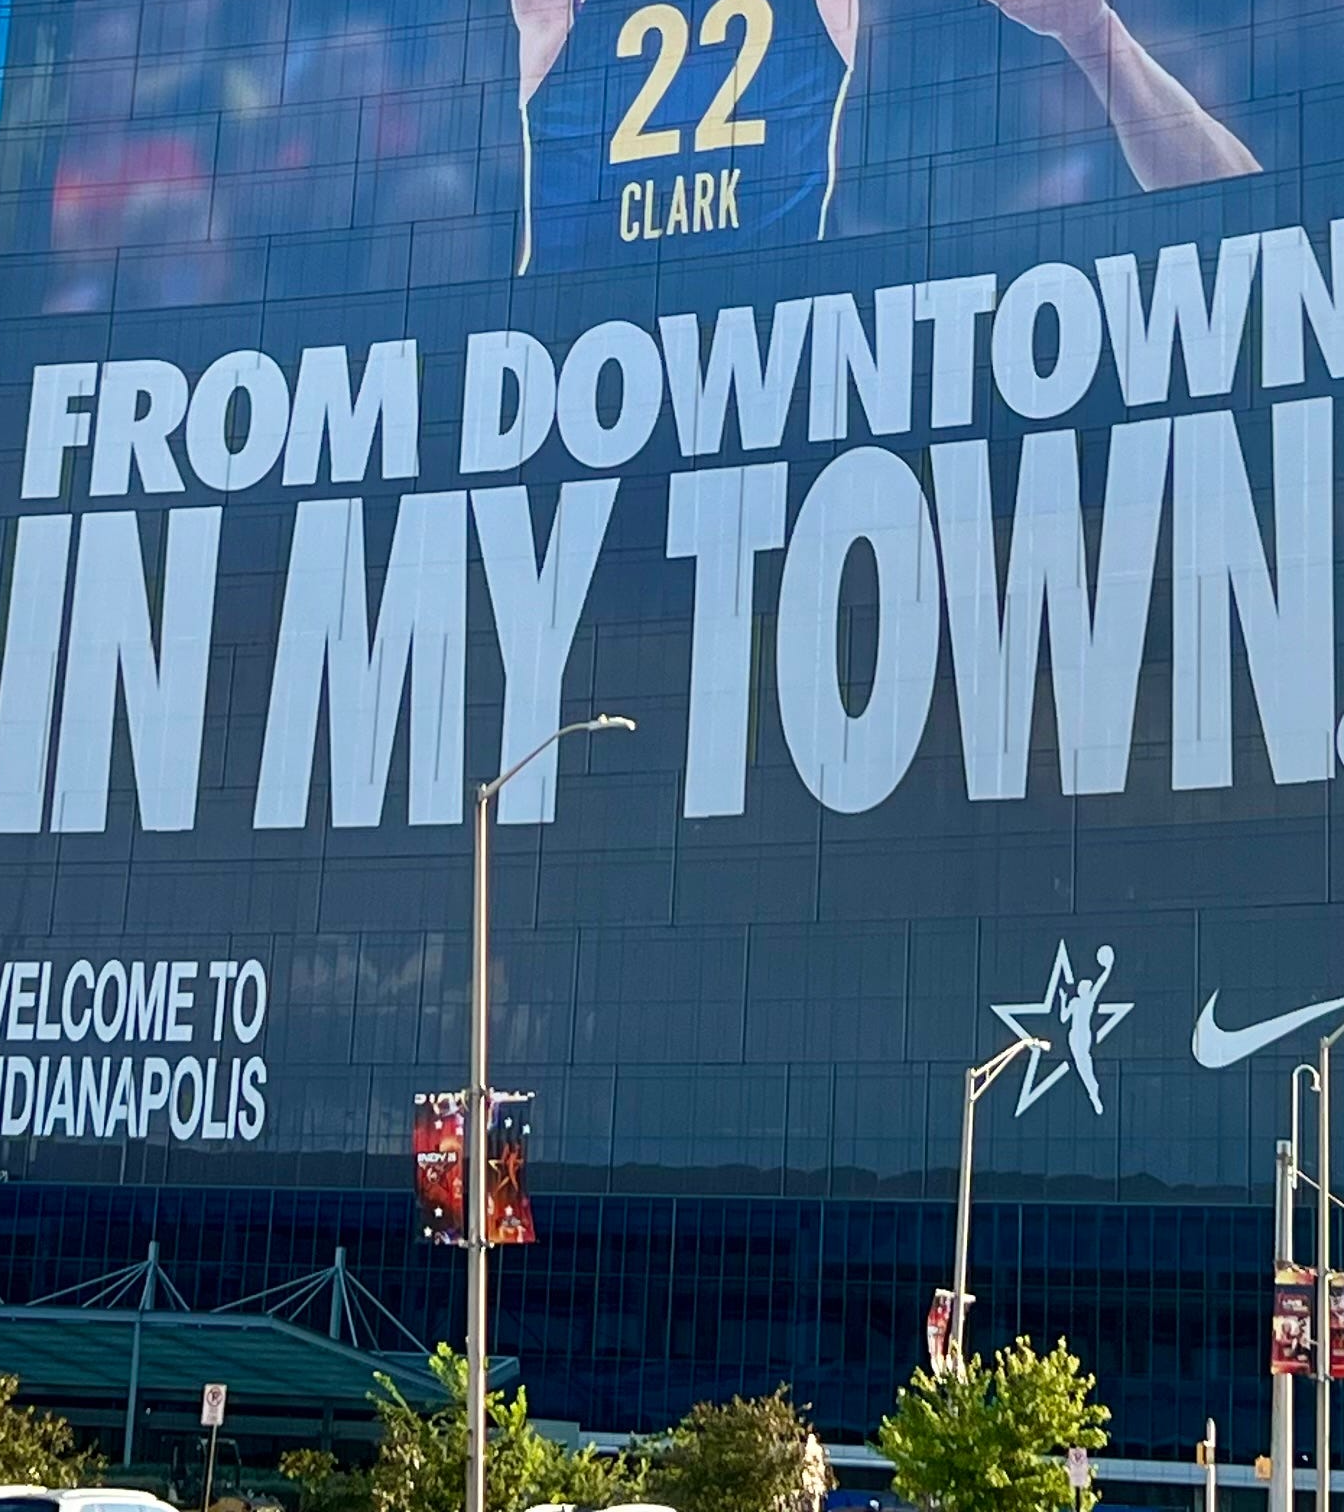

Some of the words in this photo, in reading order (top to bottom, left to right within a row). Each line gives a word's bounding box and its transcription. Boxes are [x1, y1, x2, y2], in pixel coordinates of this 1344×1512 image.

[619, 168, 741, 242] CLARK
[21, 339, 420, 499] FROM
[253, 477, 621, 829] MY
[209, 959, 267, 1044] TO
